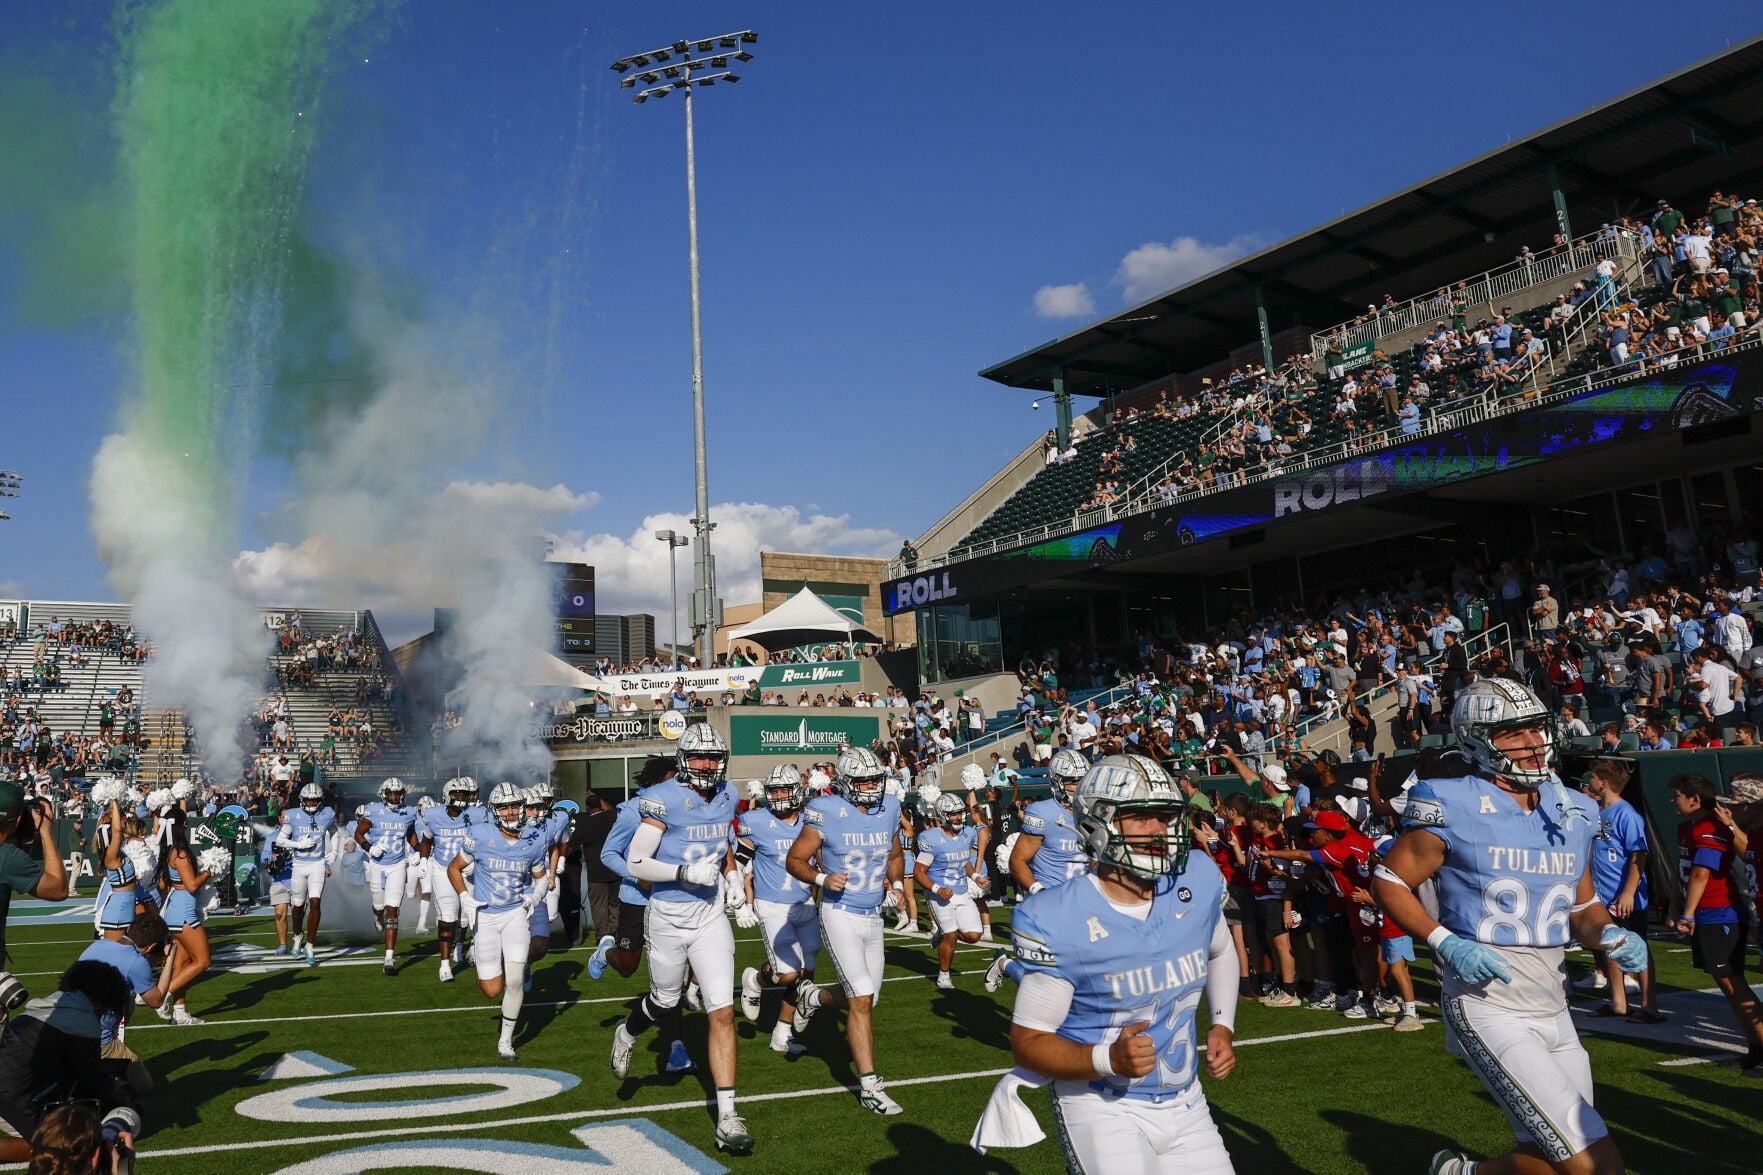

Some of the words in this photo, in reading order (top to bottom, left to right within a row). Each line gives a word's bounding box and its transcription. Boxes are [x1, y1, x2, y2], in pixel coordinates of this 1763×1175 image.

[1274, 461, 1387, 518] ROLL
[897, 572, 957, 609] ROLL
[573, 595, 584, 606] 0
[727, 674, 745, 682] nola
[781, 669, 811, 683] ROLL
[812, 667, 845, 681] WAVE
[620, 679, 639, 690] The
[663, 718, 684, 729] nola
[760, 730, 799, 743] STANDARD
[808, 730, 847, 743] MORTGAGE
[843, 831, 889, 846] TULANE
[1488, 845, 1577, 876] TULANE
[1608, 847, 1617, 863] 8
[488, 859, 529, 872] TULANE
[843, 848, 890, 892] 82
[1476, 876, 1577, 947] 86
[1104, 948, 1208, 1001] TULANE
